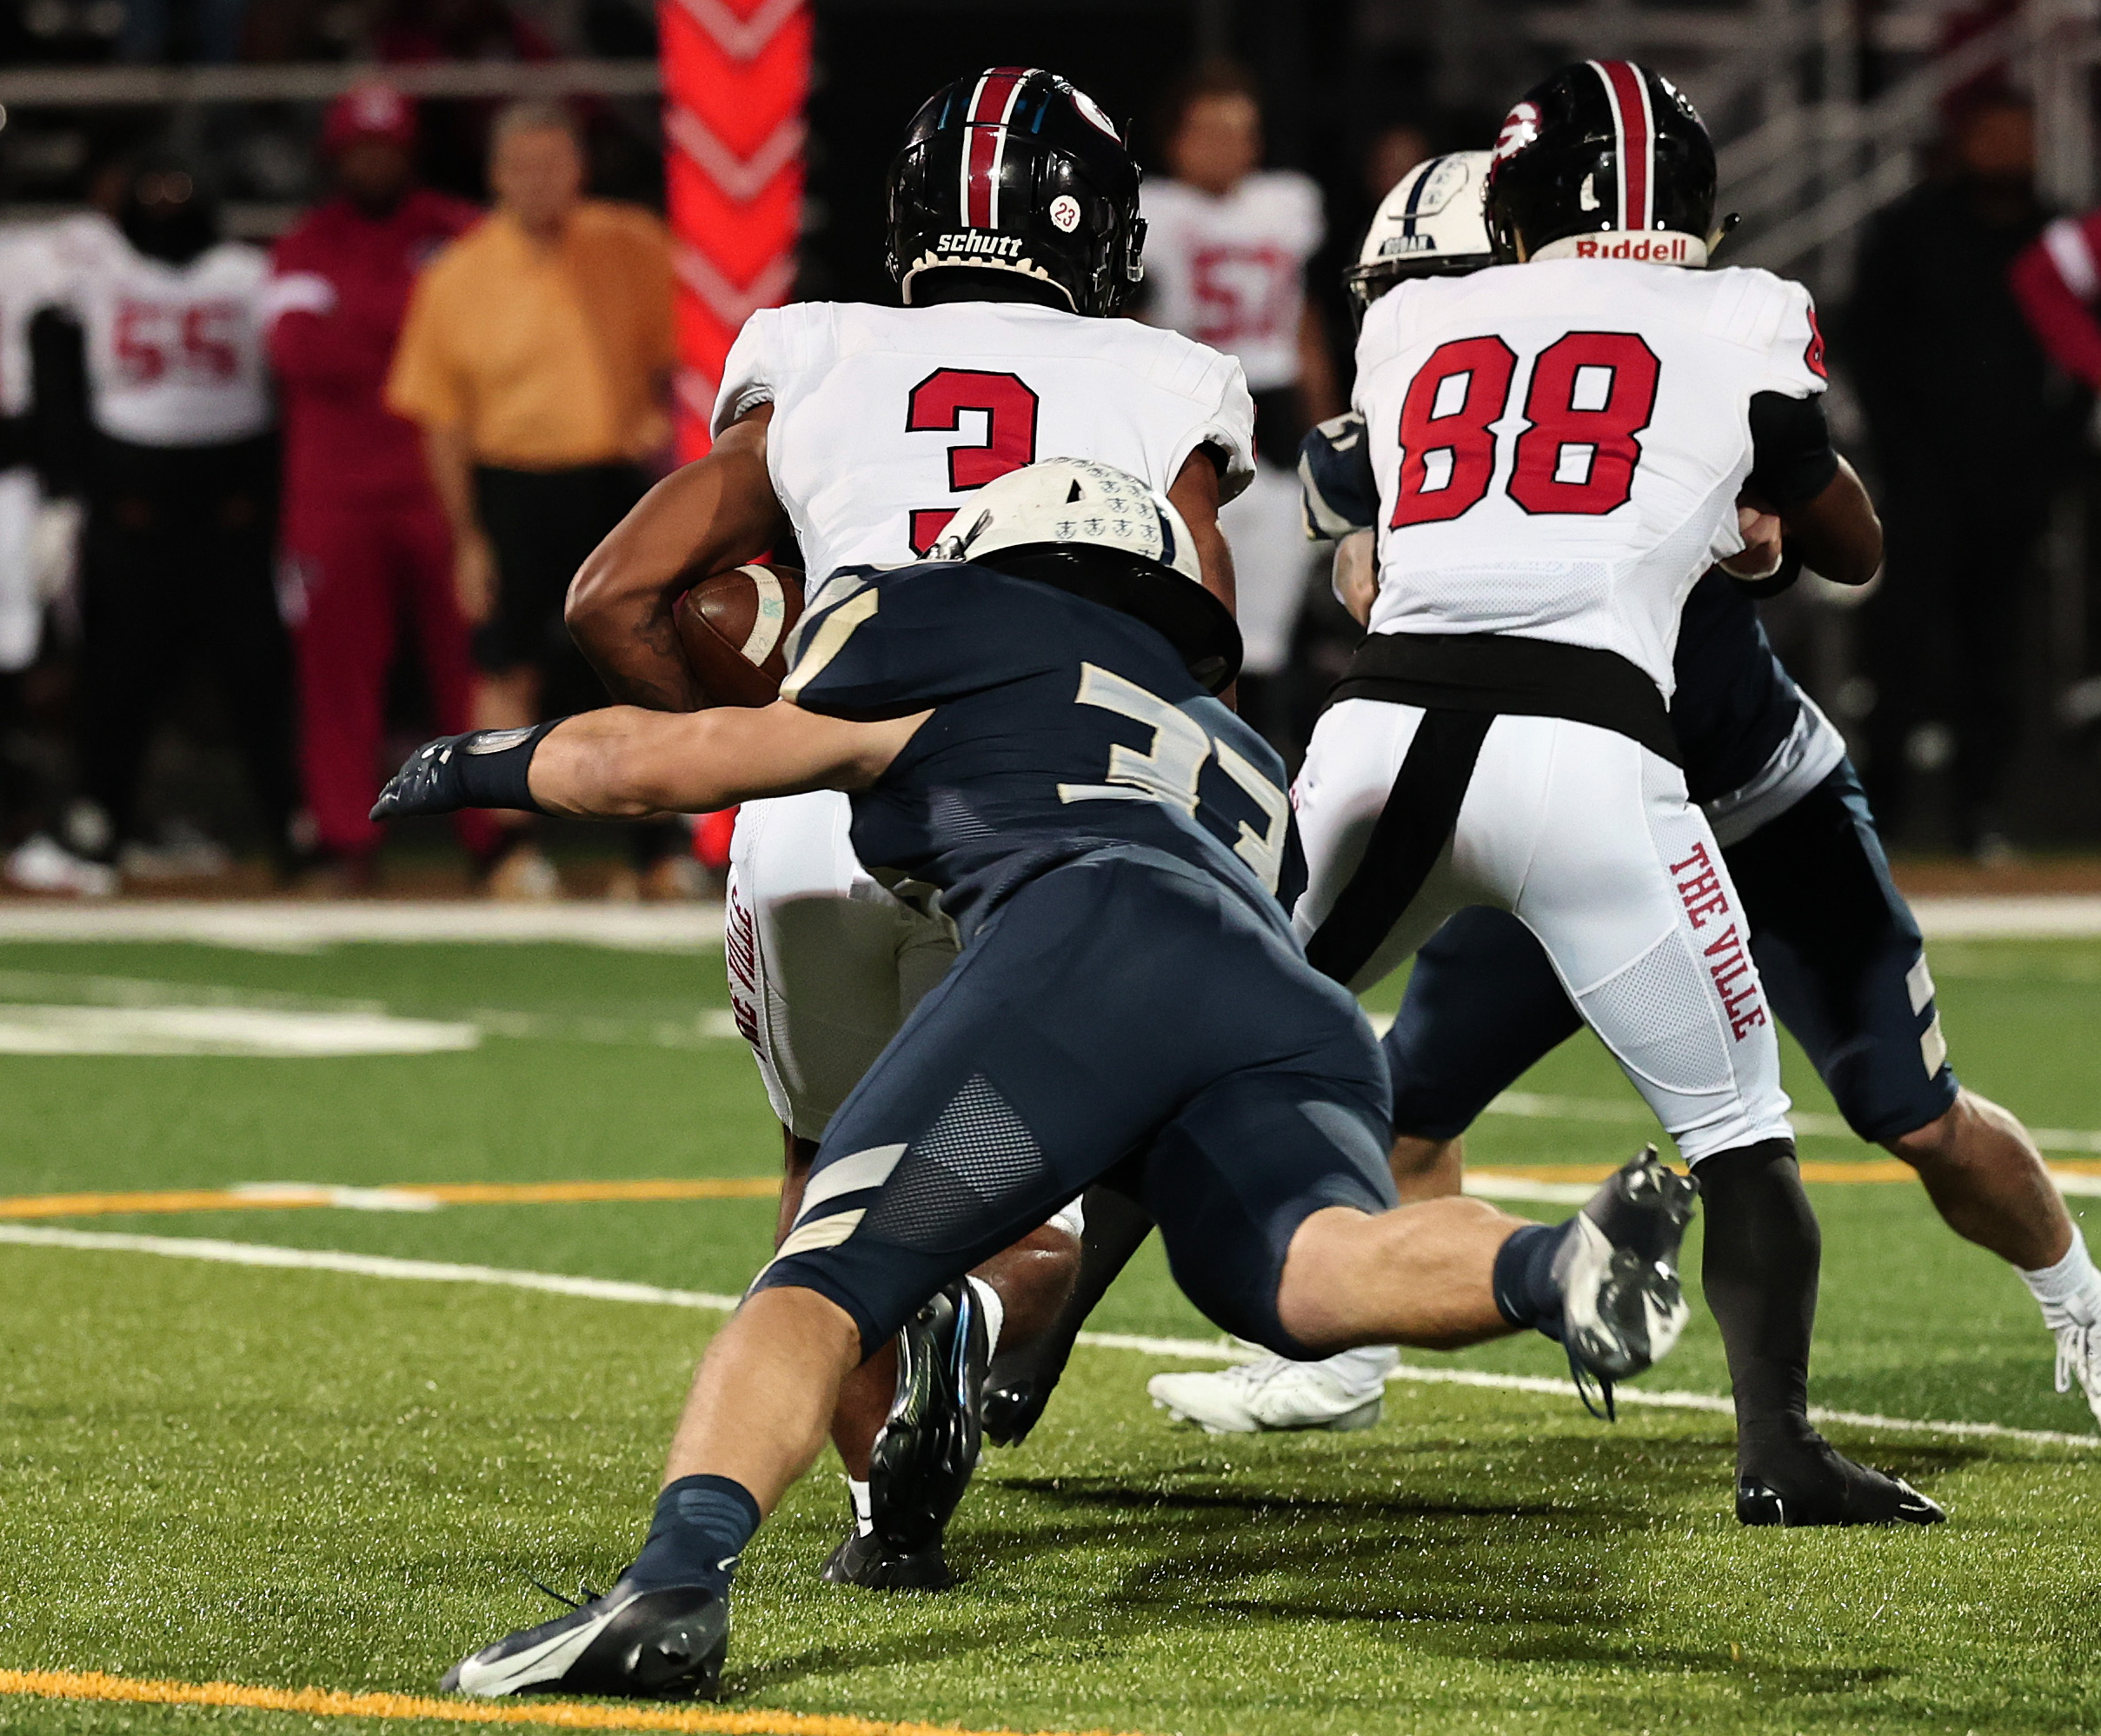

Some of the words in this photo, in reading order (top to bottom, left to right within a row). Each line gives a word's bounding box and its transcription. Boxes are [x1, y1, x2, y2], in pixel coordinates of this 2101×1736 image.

[936, 229, 1023, 257] schutt
[1054, 202, 1076, 227] 23
[1576, 238, 1686, 261] Riddell
[905, 367, 1039, 555] 3
[1388, 330, 1661, 533] 88
[1670, 841, 1729, 930] THE
[1703, 923, 1767, 1042] VILLE
